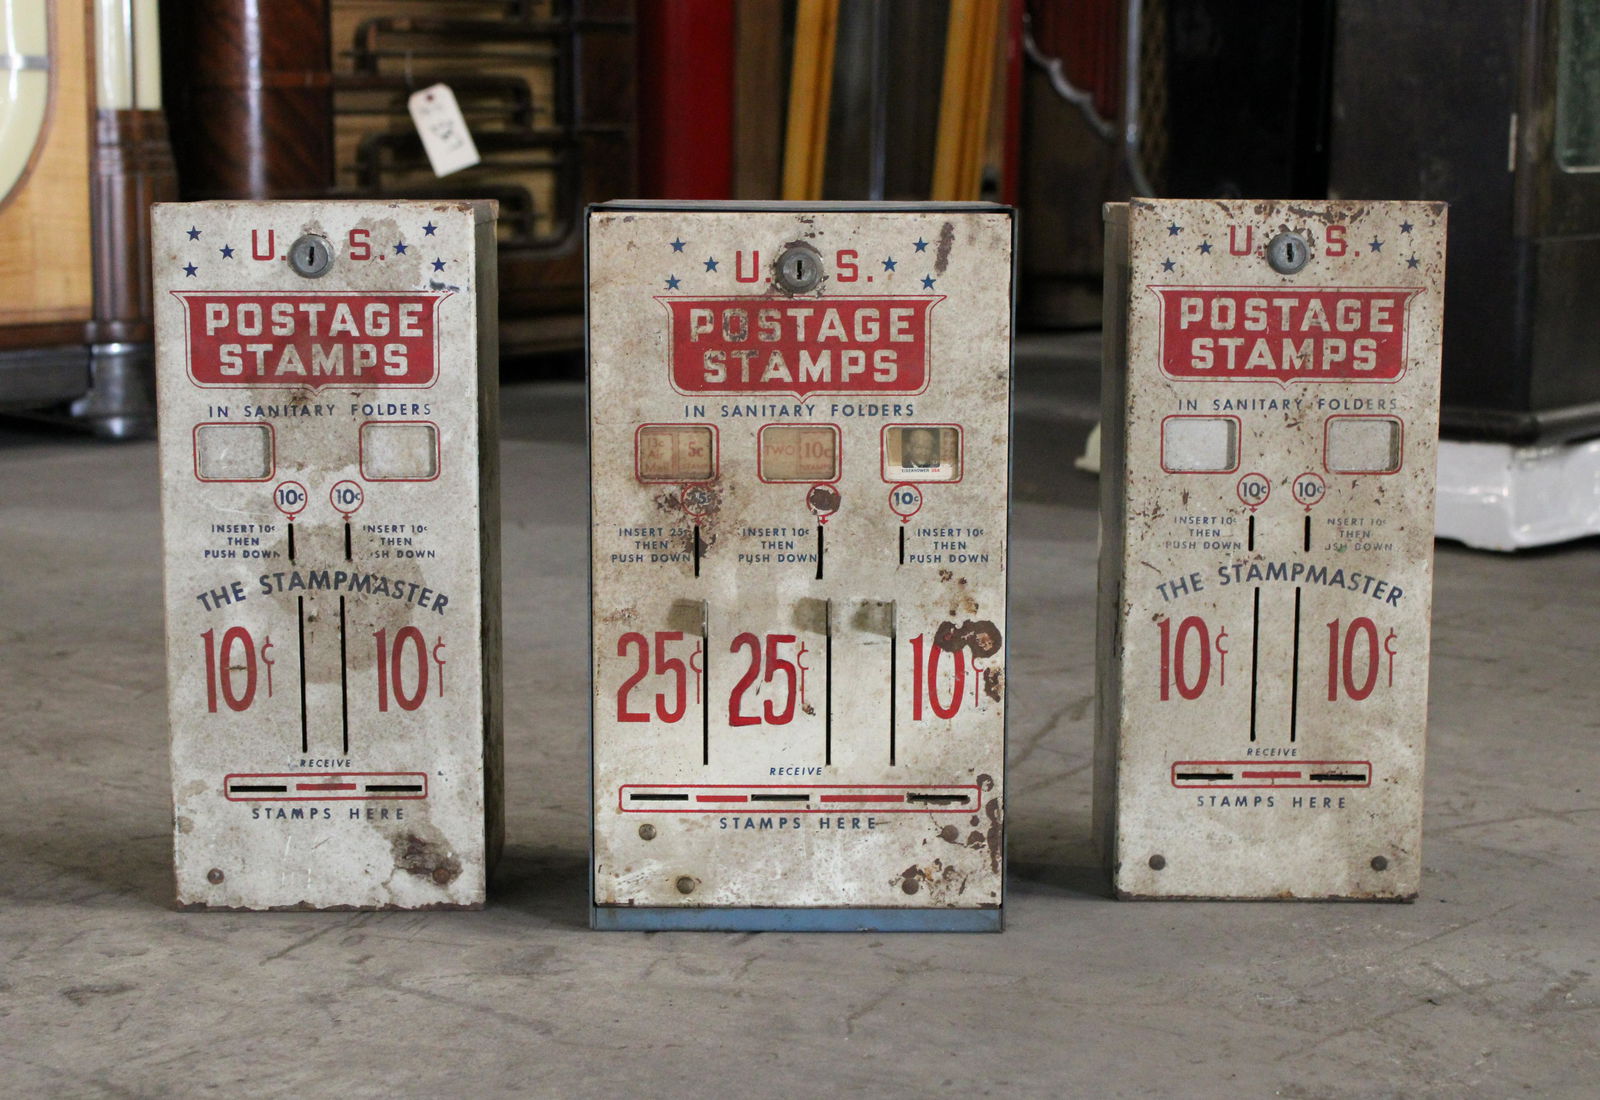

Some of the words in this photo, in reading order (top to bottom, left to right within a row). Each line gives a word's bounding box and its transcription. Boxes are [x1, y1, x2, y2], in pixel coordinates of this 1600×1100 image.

[350, 229, 385, 261] S.
[1325, 225, 1360, 257] S.
[836, 249, 874, 283] S.
[1180, 297, 1395, 332] POSTAGE
[205, 303, 424, 337] POSTAGE
[689, 307, 915, 343] POSTAGE
[1190, 338, 1377, 371] STAMPS
[219, 343, 409, 377] STAMPS
[703, 349, 898, 383] STAMPS
[1178, 399, 1198, 411] IN
[1213, 399, 1303, 411] SANITARY
[1318, 398, 1398, 411] FOLDERS
[208, 405, 229, 418] IN
[244, 404, 336, 418] SANITARY
[351, 403, 432, 416] FOLDERS
[685, 405, 705, 418] IN
[721, 404, 816, 418] SANITARY
[831, 404, 915, 417] FOLDERS
[1174, 516, 1217, 525] INSERT
[1327, 518, 1364, 526] NSERT
[211, 524, 255, 533] INSERT
[618, 527, 663, 537] INSERT
[742, 528, 786, 537] INSERT
[917, 528, 962, 537] INSERT
[1189, 529, 1221, 537] THEN
[1339, 530, 1371, 538] THEN
[227, 537, 260, 546] THEN
[380, 537, 412, 546] THEN
[635, 541, 668, 549] THEN
[761, 541, 794, 550] THEN
[933, 541, 967, 550] THEN
[1165, 541, 1196, 549] PUSH
[1203, 541, 1241, 550] DOWN
[1354, 542, 1393, 551] DOWN
[204, 549, 236, 558] PUSH
[396, 550, 436, 558] DOWN
[611, 554, 644, 563] PUSH
[651, 554, 691, 563] DOWN
[738, 554, 770, 563] PUSH
[778, 554, 817, 563] DOWN
[909, 554, 942, 563] PUSH
[949, 554, 989, 563] DOWN
[1156, 572, 1204, 602] THE
[1218, 562, 1404, 607] STAMPMASTER
[196, 581, 247, 612] THE
[259, 570, 449, 616] STAMPMASTER
[1246, 748, 1298, 757] RECEIVE
[299, 758, 352, 768] RECEIVE
[769, 766, 823, 776] RECEIVE
[1197, 795, 1275, 808] STAMPS
[1292, 796, 1346, 809] HERE
[251, 807, 332, 820] STAMPS
[350, 807, 405, 820] HERE
[720, 817, 801, 830] STAMPS
[819, 817, 877, 830] HERE
